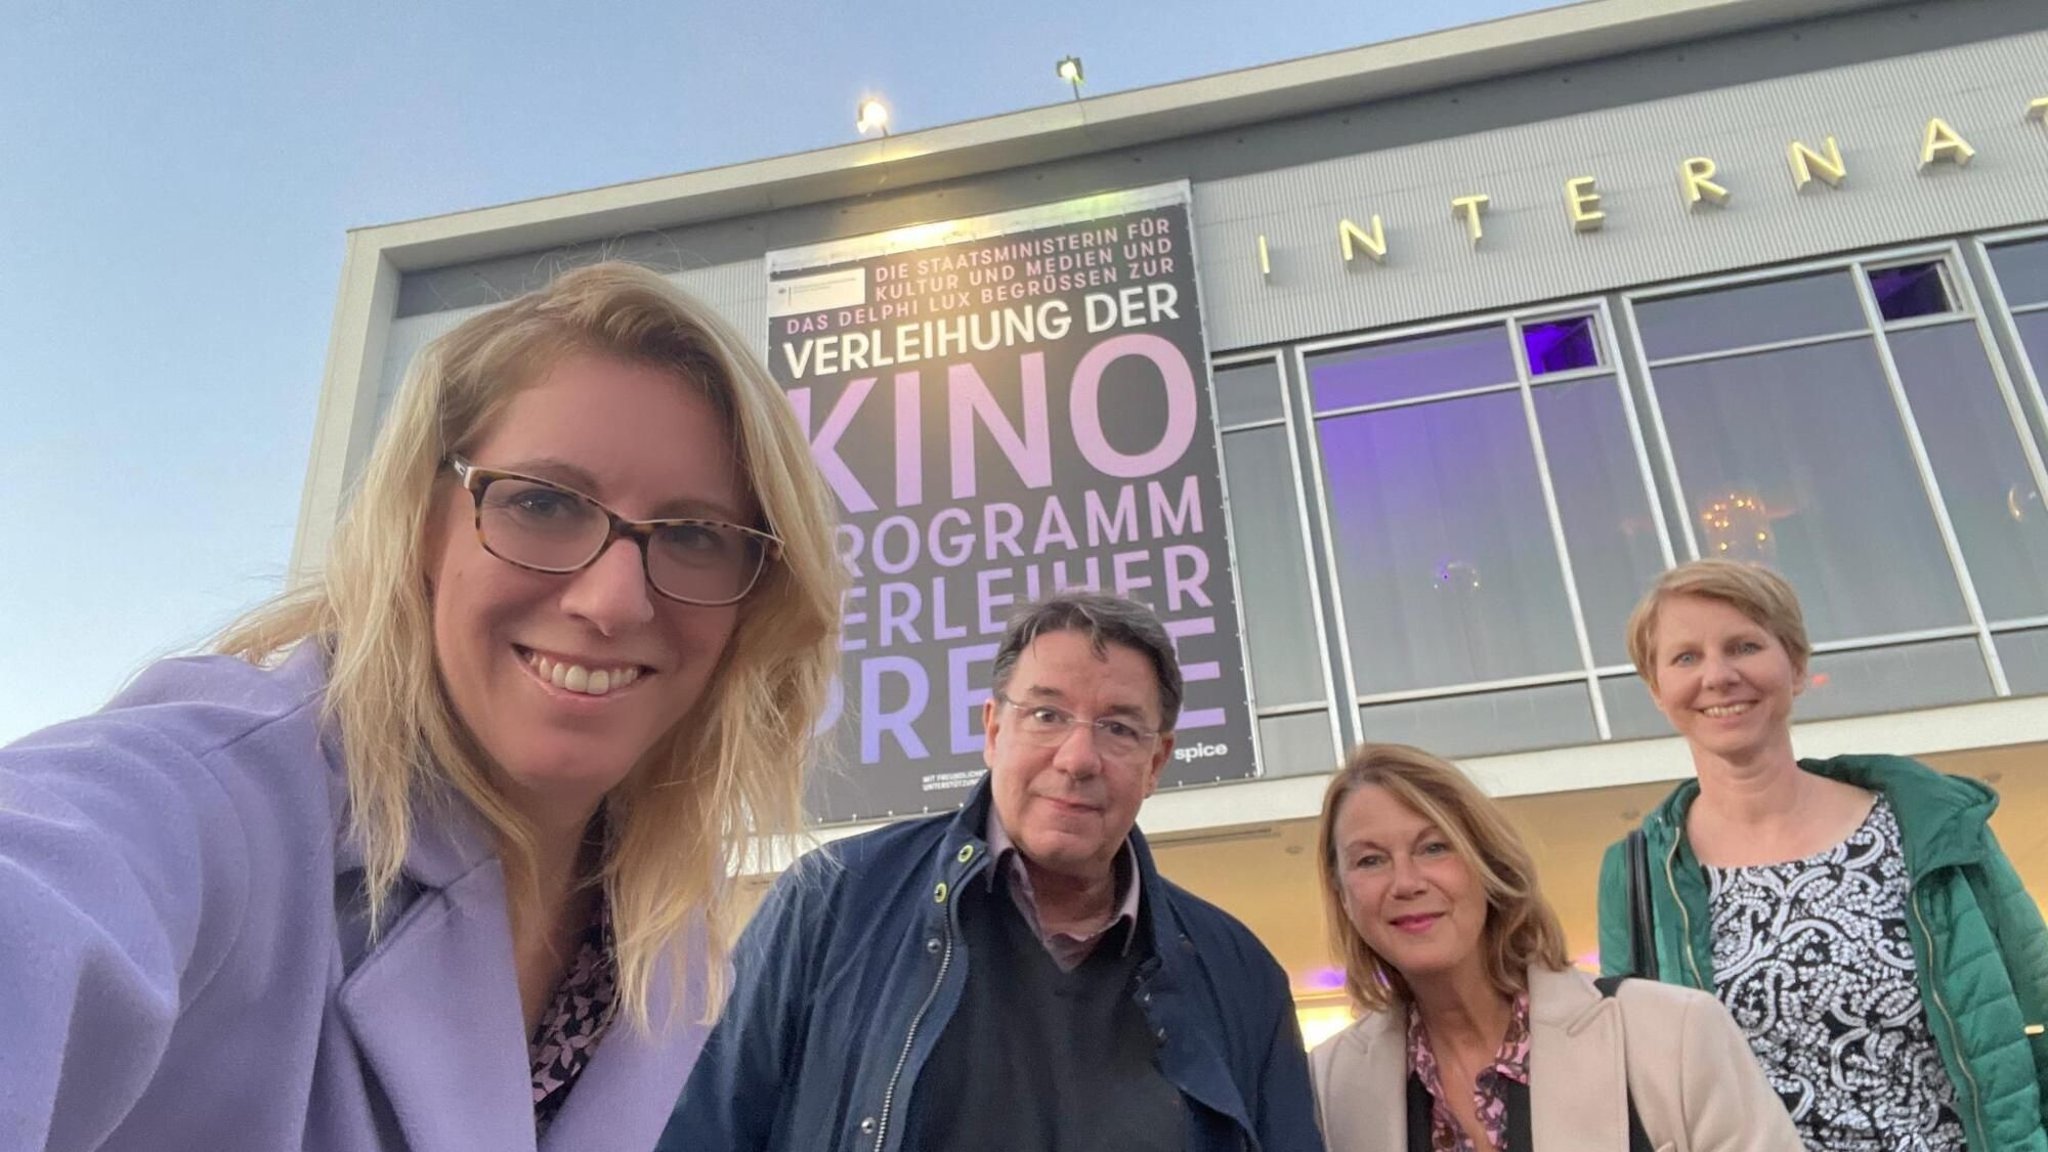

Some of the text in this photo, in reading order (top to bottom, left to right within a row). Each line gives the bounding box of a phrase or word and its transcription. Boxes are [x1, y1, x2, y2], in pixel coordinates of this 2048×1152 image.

[875, 218, 1170, 283] DIE STAATSMINISTERIN FÜR
[875, 274, 960, 302] KULTUR
[969, 266, 1016, 290] UND
[1025, 248, 1113, 277] MEDIEN
[1123, 237, 1173, 260] UND
[783, 282, 1180, 379] VERLEIHUNG DER
[787, 257, 1175, 335] DAS DELPHI LUX BEGRÜSSEN ZUR
[786, 333, 1198, 514] KINO
[834, 475, 1204, 577] ROGRAMM
[1174, 742, 1228, 763] spice
